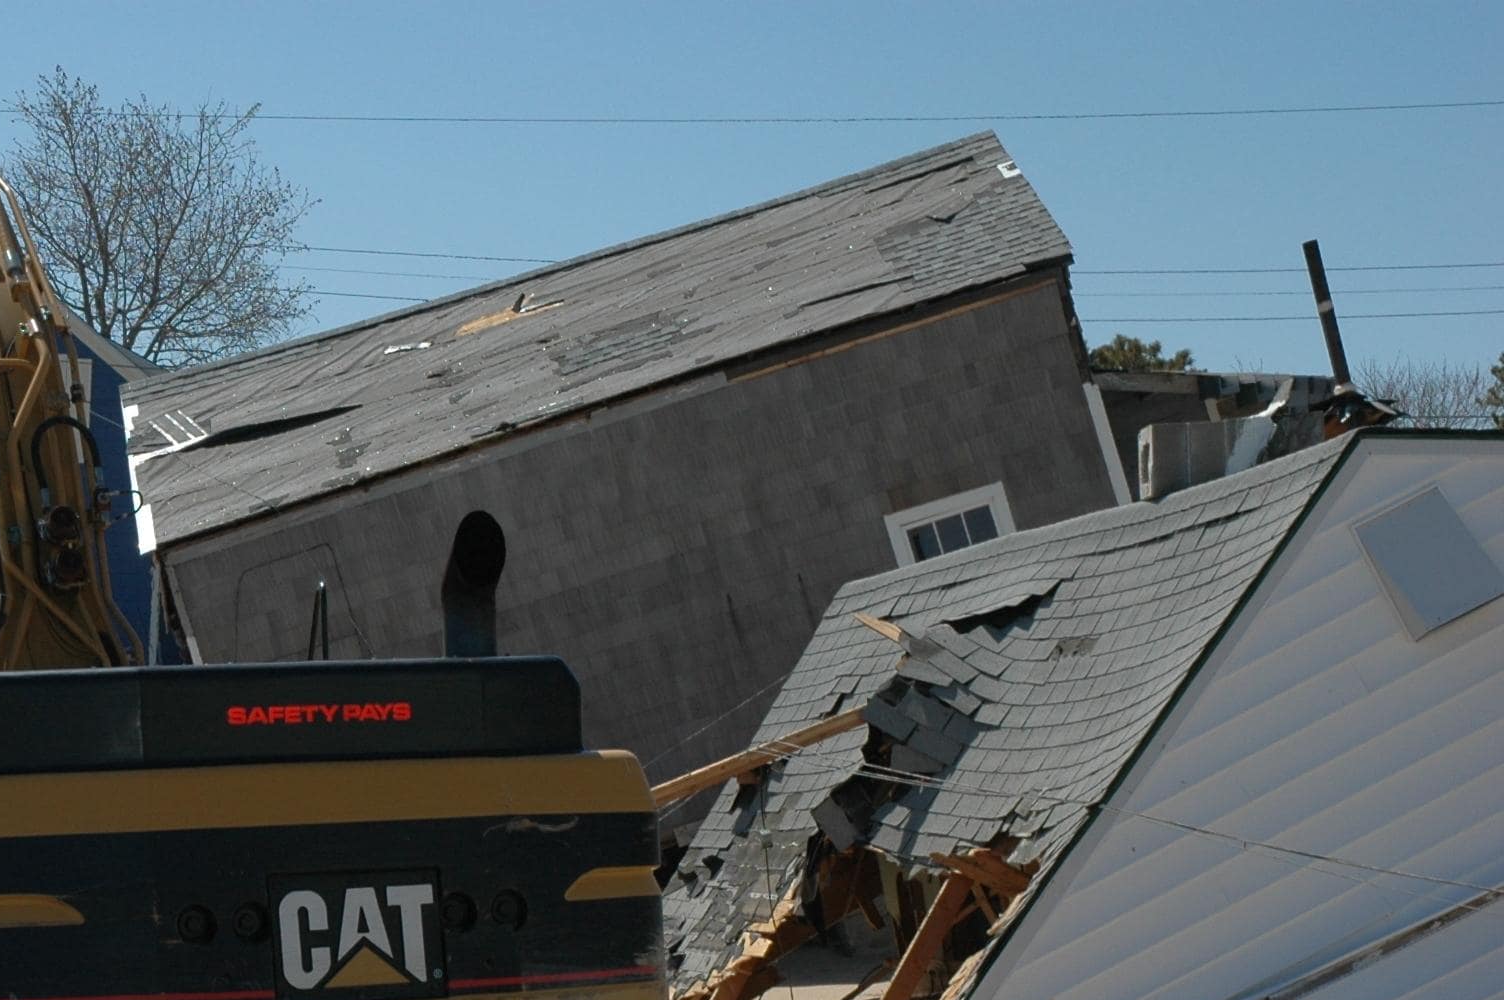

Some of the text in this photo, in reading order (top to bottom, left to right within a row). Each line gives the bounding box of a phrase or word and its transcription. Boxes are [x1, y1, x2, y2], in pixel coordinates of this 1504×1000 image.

[227, 703, 411, 725] SAFETY PAYS
[278, 884, 434, 990] CAT
